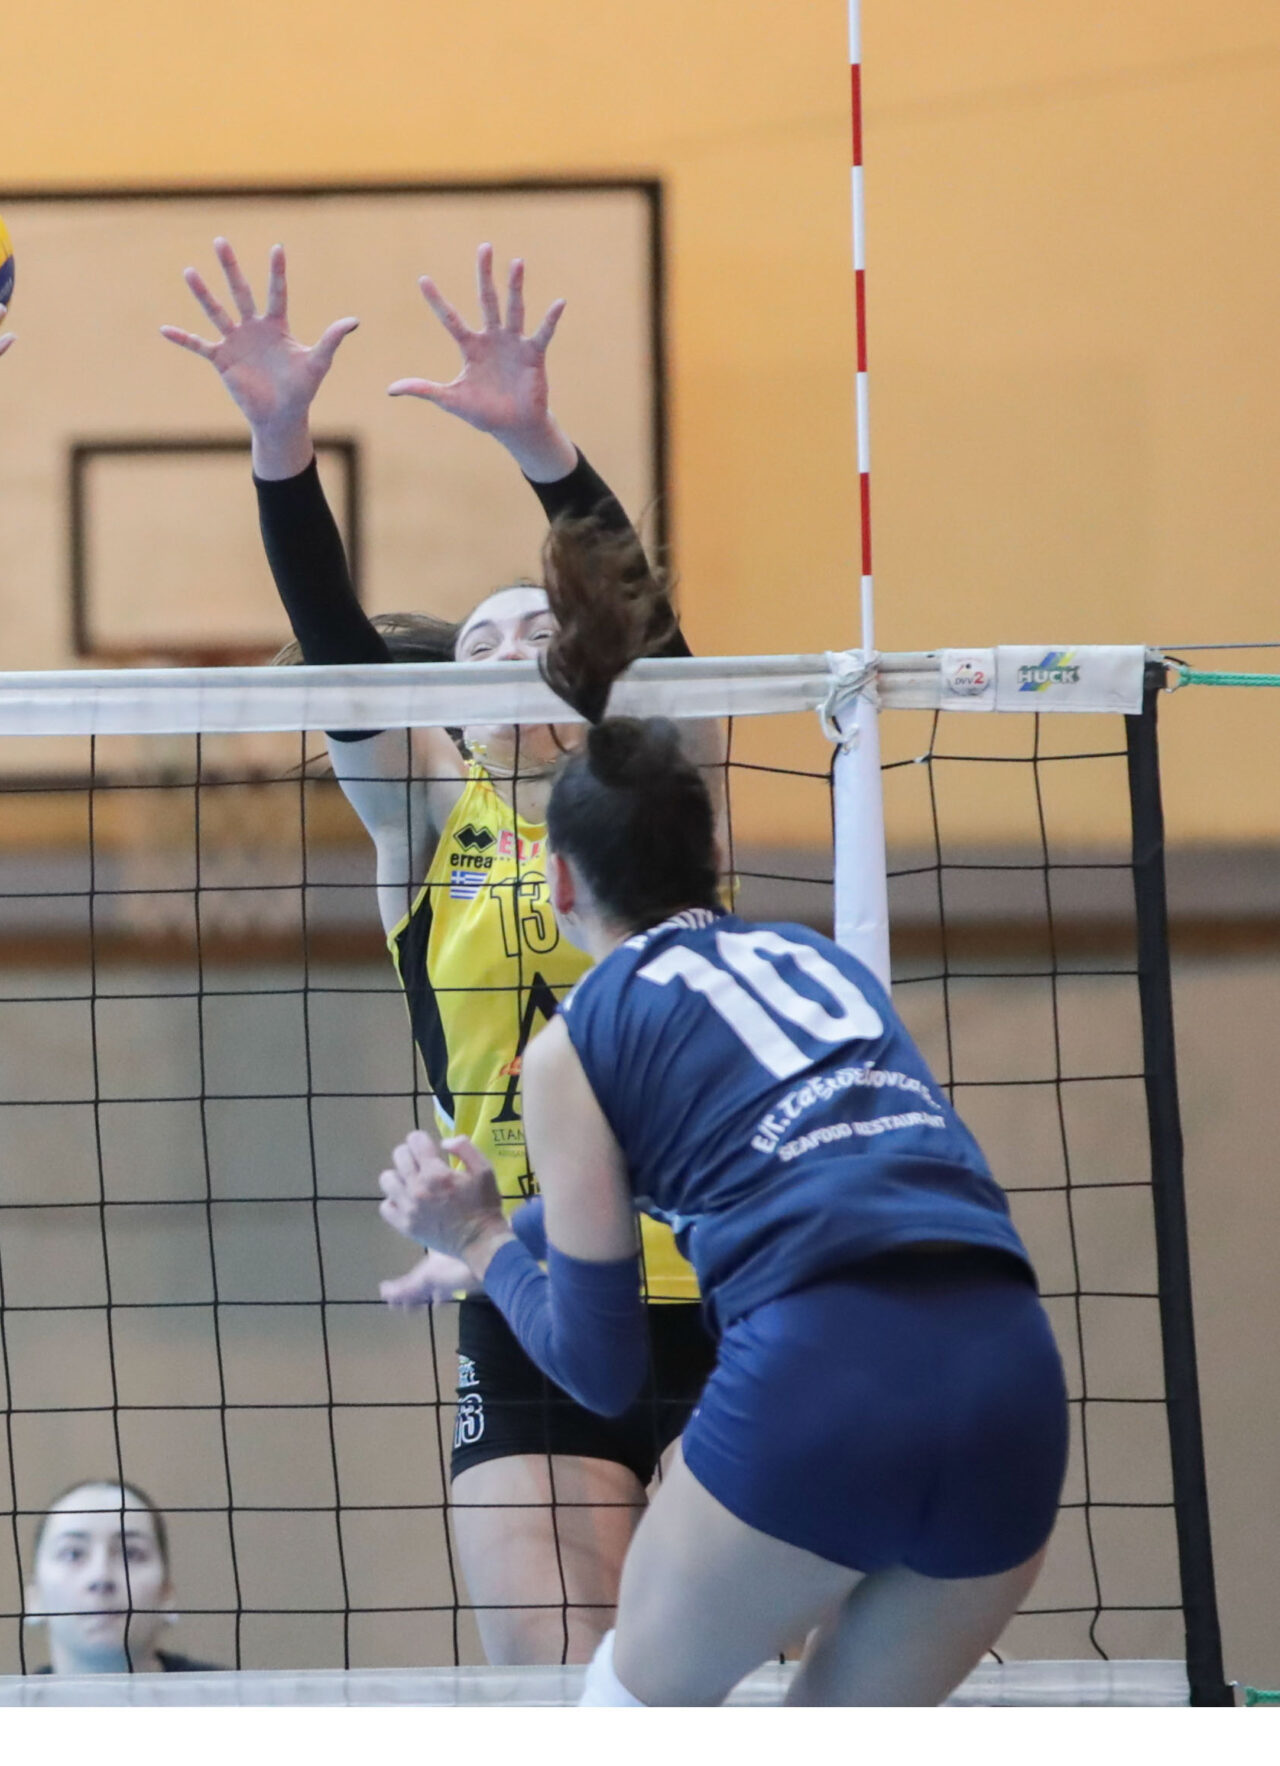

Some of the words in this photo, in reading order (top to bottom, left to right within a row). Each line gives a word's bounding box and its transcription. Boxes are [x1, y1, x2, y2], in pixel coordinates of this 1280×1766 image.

[450, 852, 493, 869] errea
[490, 871, 559, 958] 13
[636, 931, 884, 1080] 10
[777, 1122, 853, 1162] SEAFOOD
[851, 1111, 947, 1137] RESTAURANT
